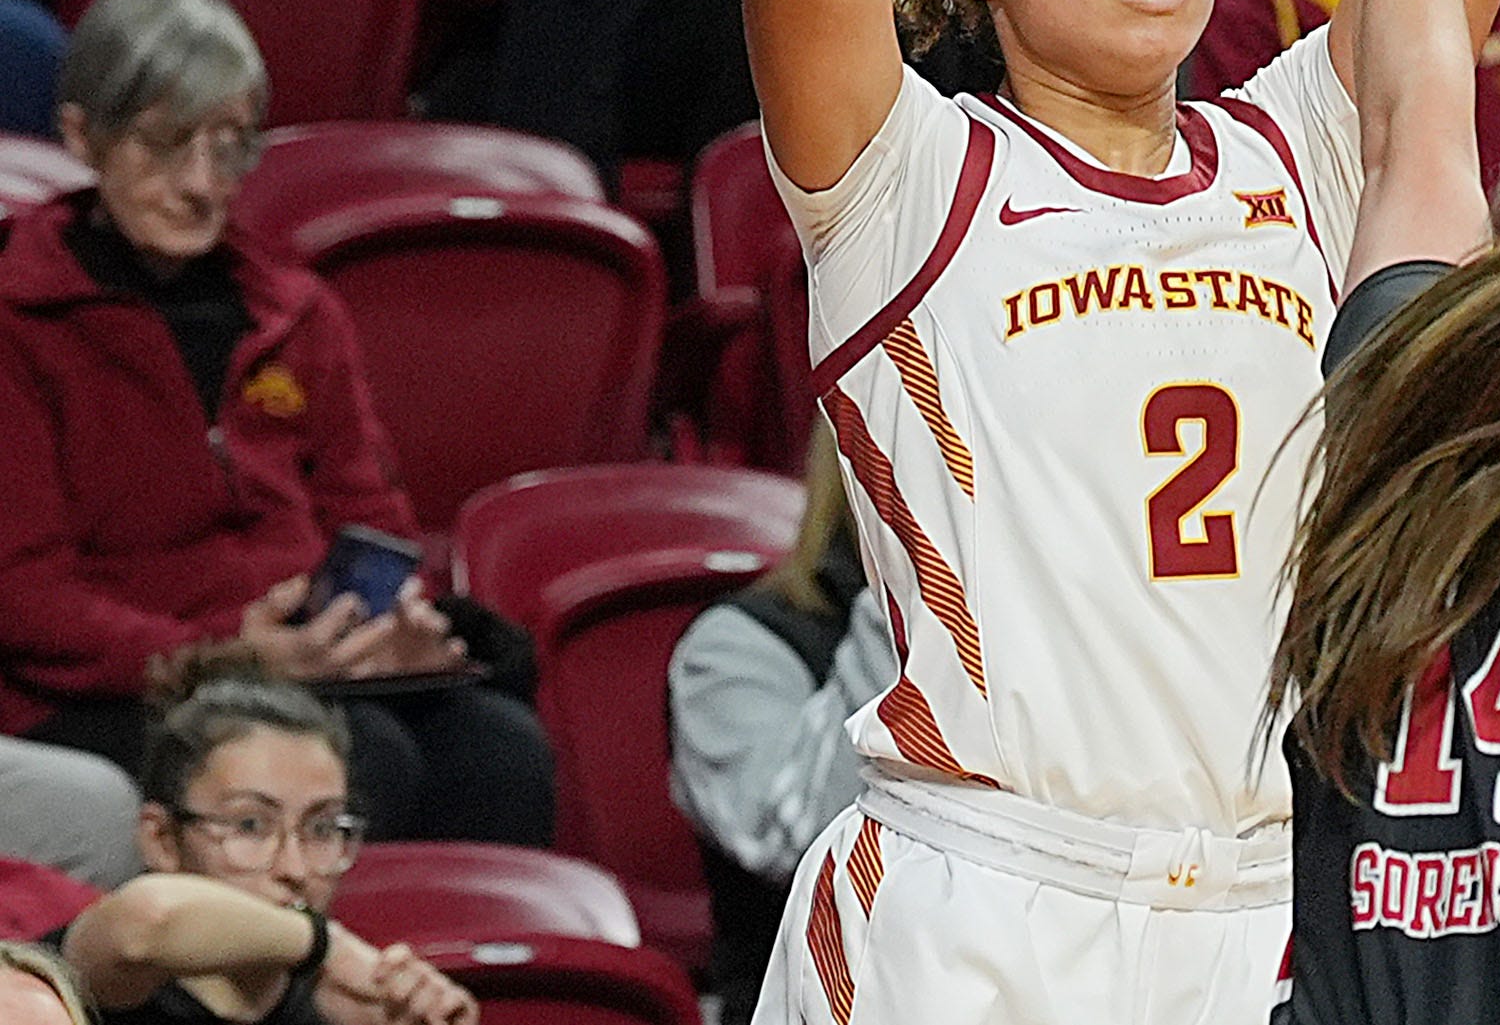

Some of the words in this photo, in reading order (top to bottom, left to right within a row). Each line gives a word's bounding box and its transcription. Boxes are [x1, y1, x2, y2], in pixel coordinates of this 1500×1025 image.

[1003, 265, 1154, 343] IOWA
[1161, 268, 1317, 352] STATE
[1140, 380, 1241, 582] 2
